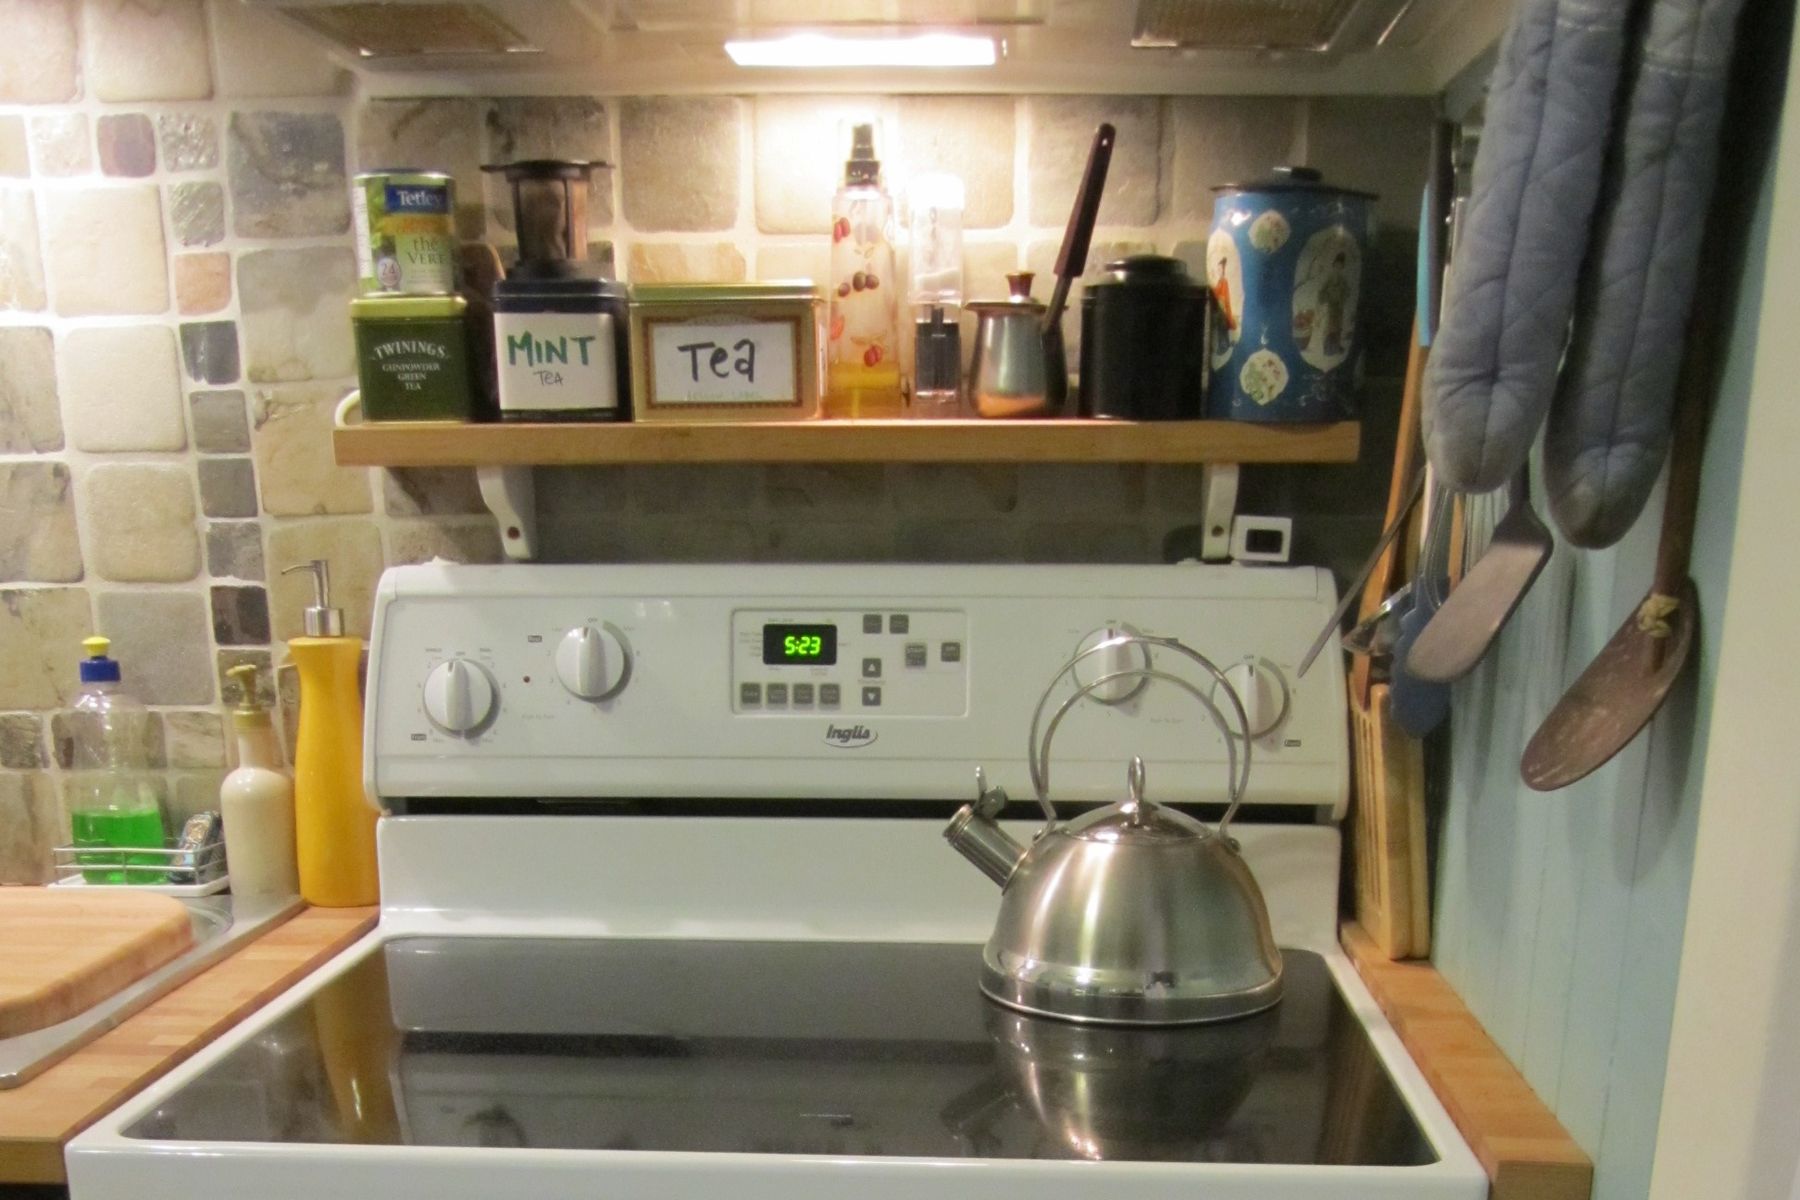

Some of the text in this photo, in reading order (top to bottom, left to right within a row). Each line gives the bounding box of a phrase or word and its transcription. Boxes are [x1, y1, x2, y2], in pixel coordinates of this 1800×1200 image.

[397, 190, 442, 210] Tetley
[374, 340, 446, 360] TWININGS
[507, 330, 596, 368] MINT
[382, 363, 440, 372] GUNPOWDER
[677, 338, 755, 384] Tea
[398, 372, 427, 381] GREEN
[405, 382, 422, 391] TEA
[784, 636, 822, 655] 5:23
[826, 725, 871, 743] Inglis
